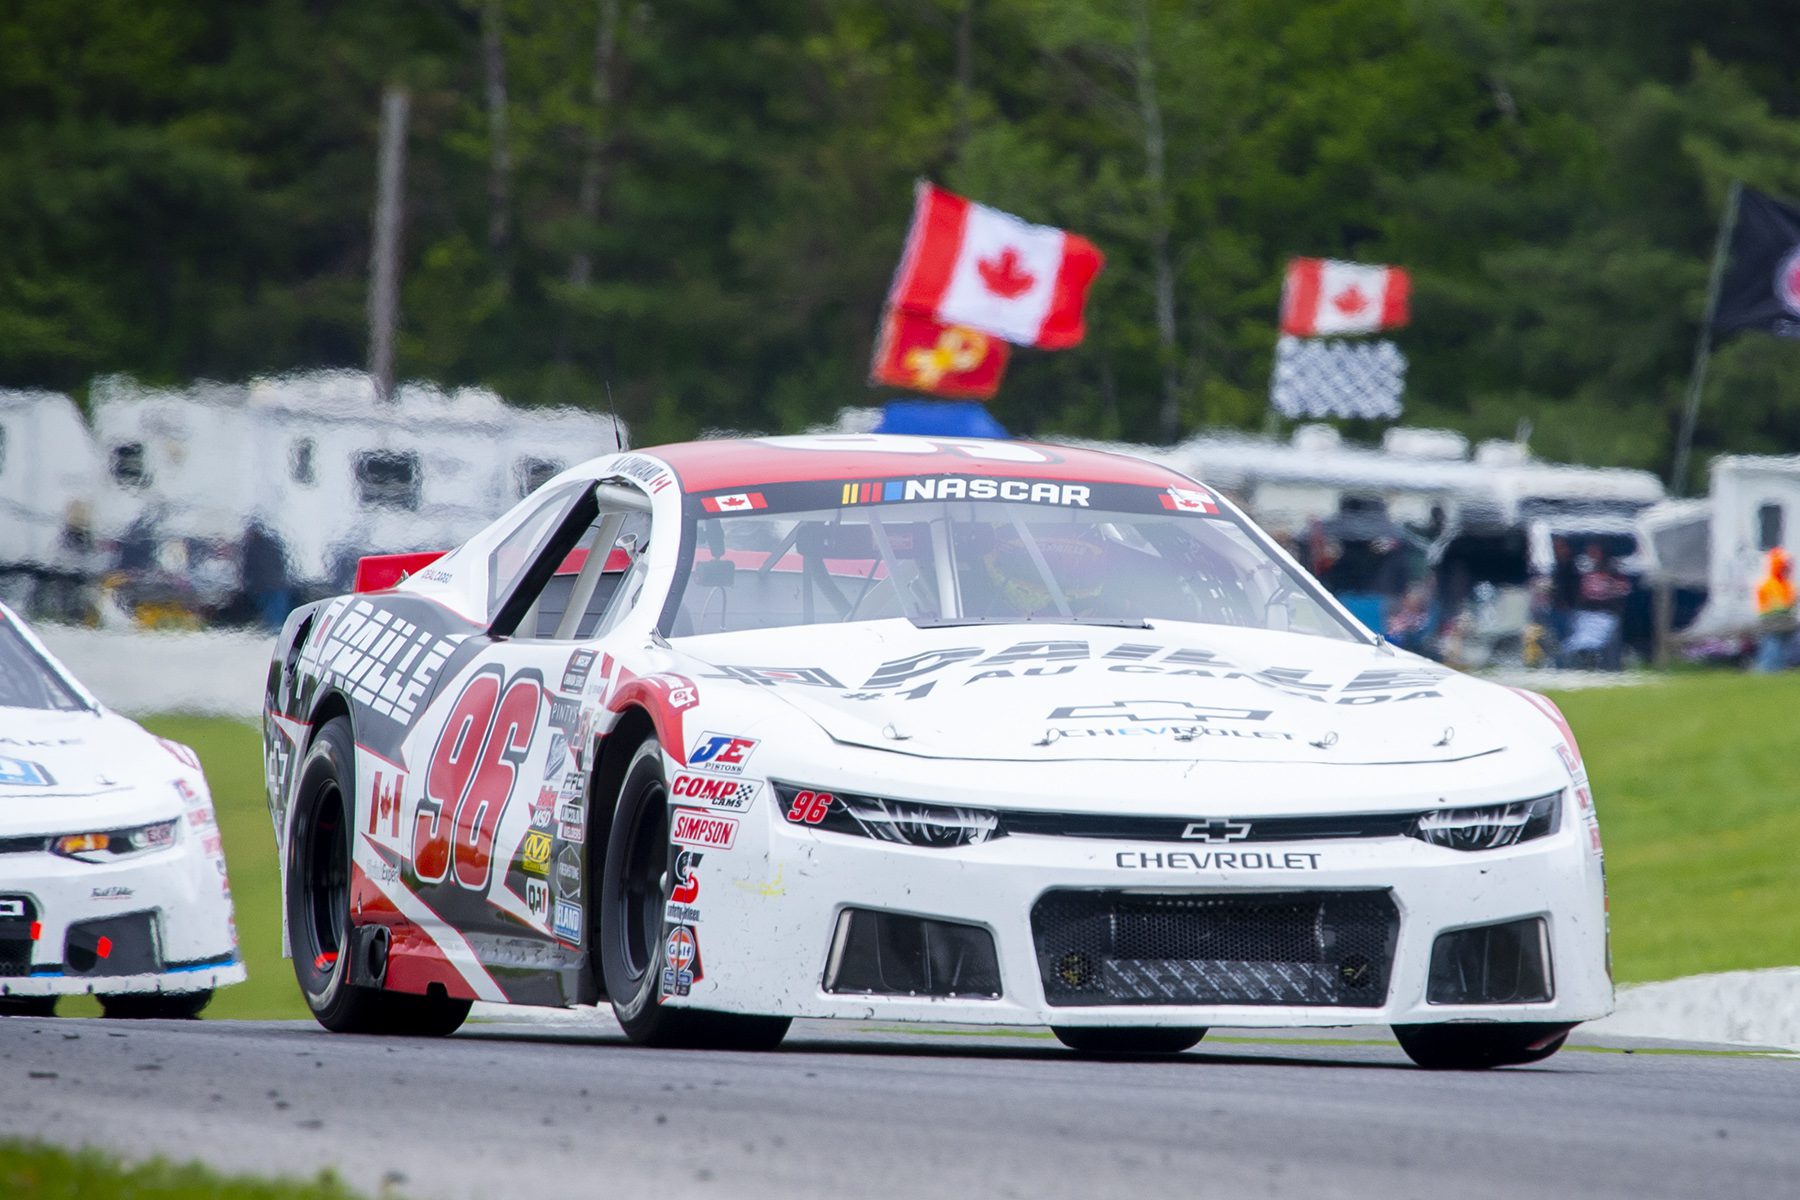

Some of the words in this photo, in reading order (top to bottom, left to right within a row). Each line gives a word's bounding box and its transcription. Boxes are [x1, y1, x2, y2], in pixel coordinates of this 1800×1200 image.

[903, 479, 1091, 507] NASCAR
[963, 666, 1078, 686] AU
[1061, 725, 1293, 740] CHEVROLET
[689, 736, 756, 764] JE
[411, 663, 545, 891] 96
[704, 762, 743, 773] PISTONS
[672, 775, 739, 800] COMP
[712, 795, 744, 809] CAMS
[787, 789, 834, 825] 96
[674, 816, 735, 845] SIMPSON
[1116, 852, 1323, 870] CHEVROLET
